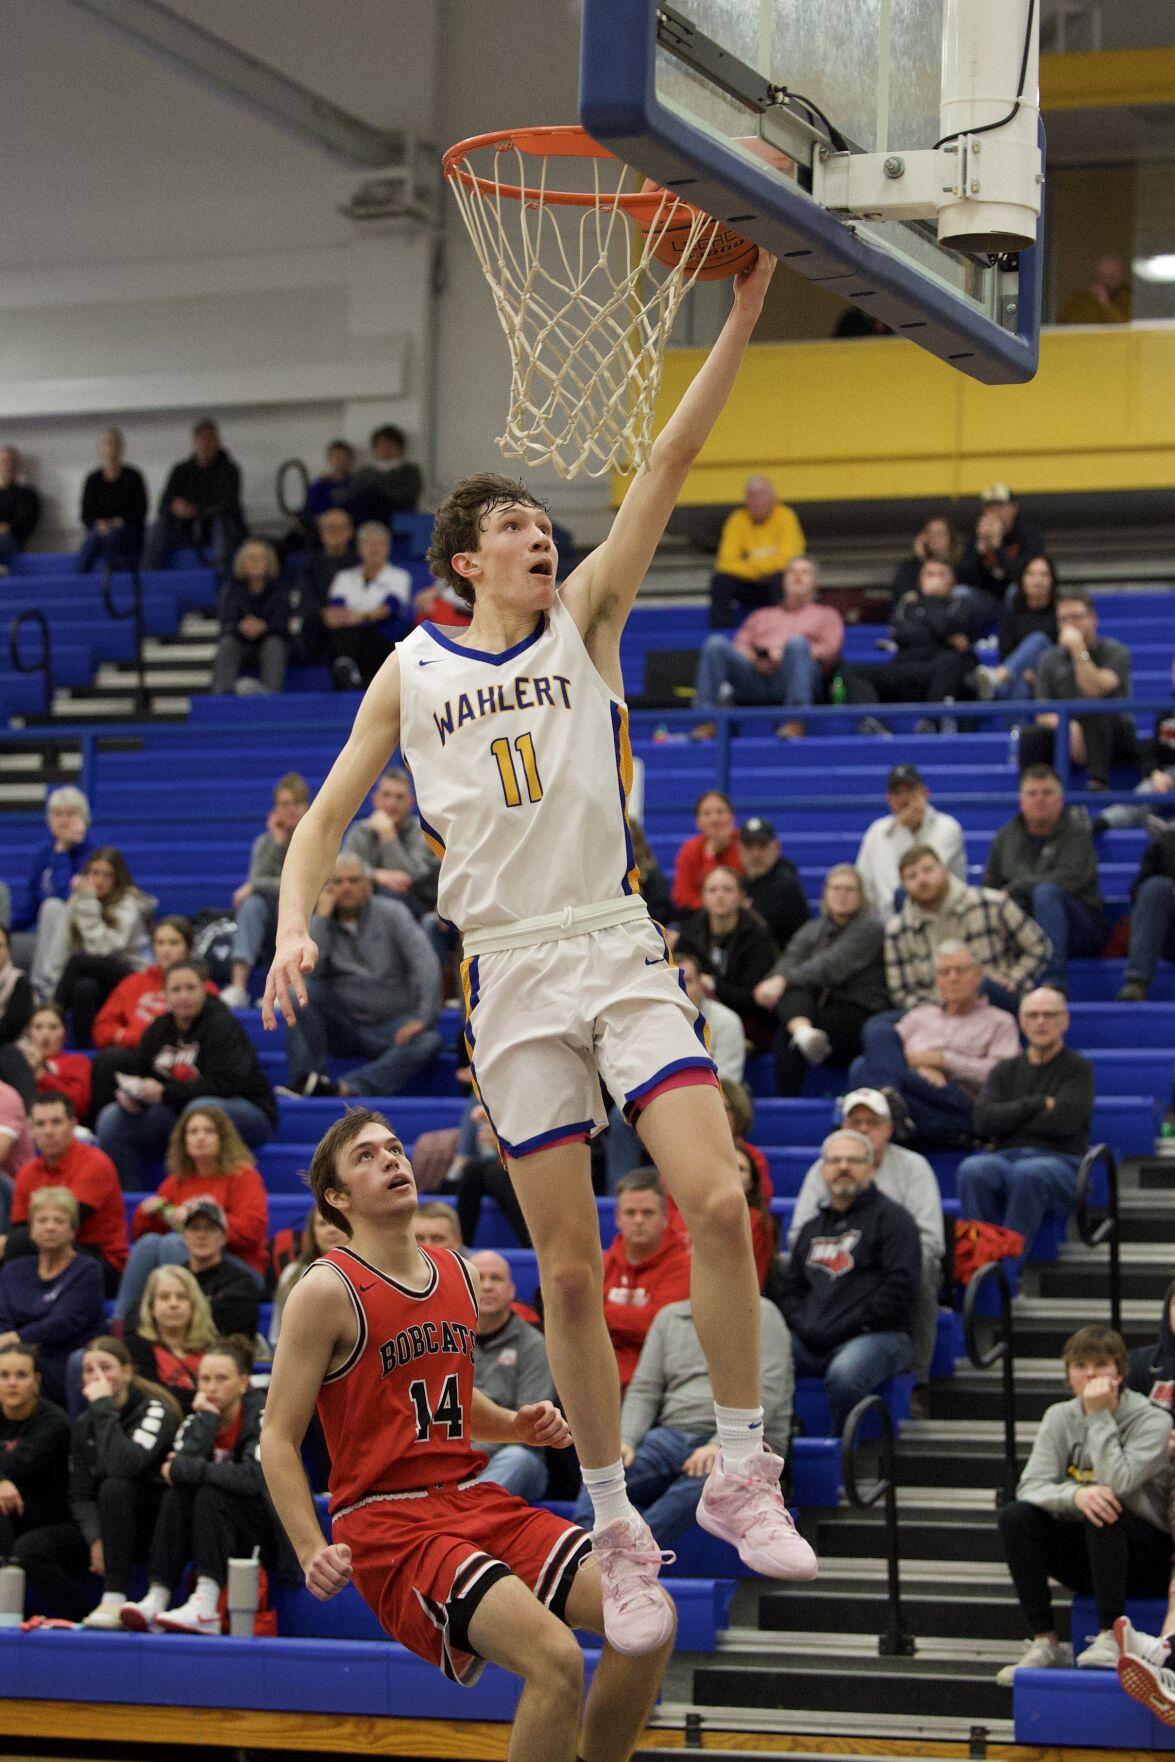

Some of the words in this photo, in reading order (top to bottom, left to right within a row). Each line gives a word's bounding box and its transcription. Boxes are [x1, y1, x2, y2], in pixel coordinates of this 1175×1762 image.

[432, 675, 572, 748] WAHLERT
[490, 731, 544, 808] 11
[408, 1372, 463, 1443] 14
